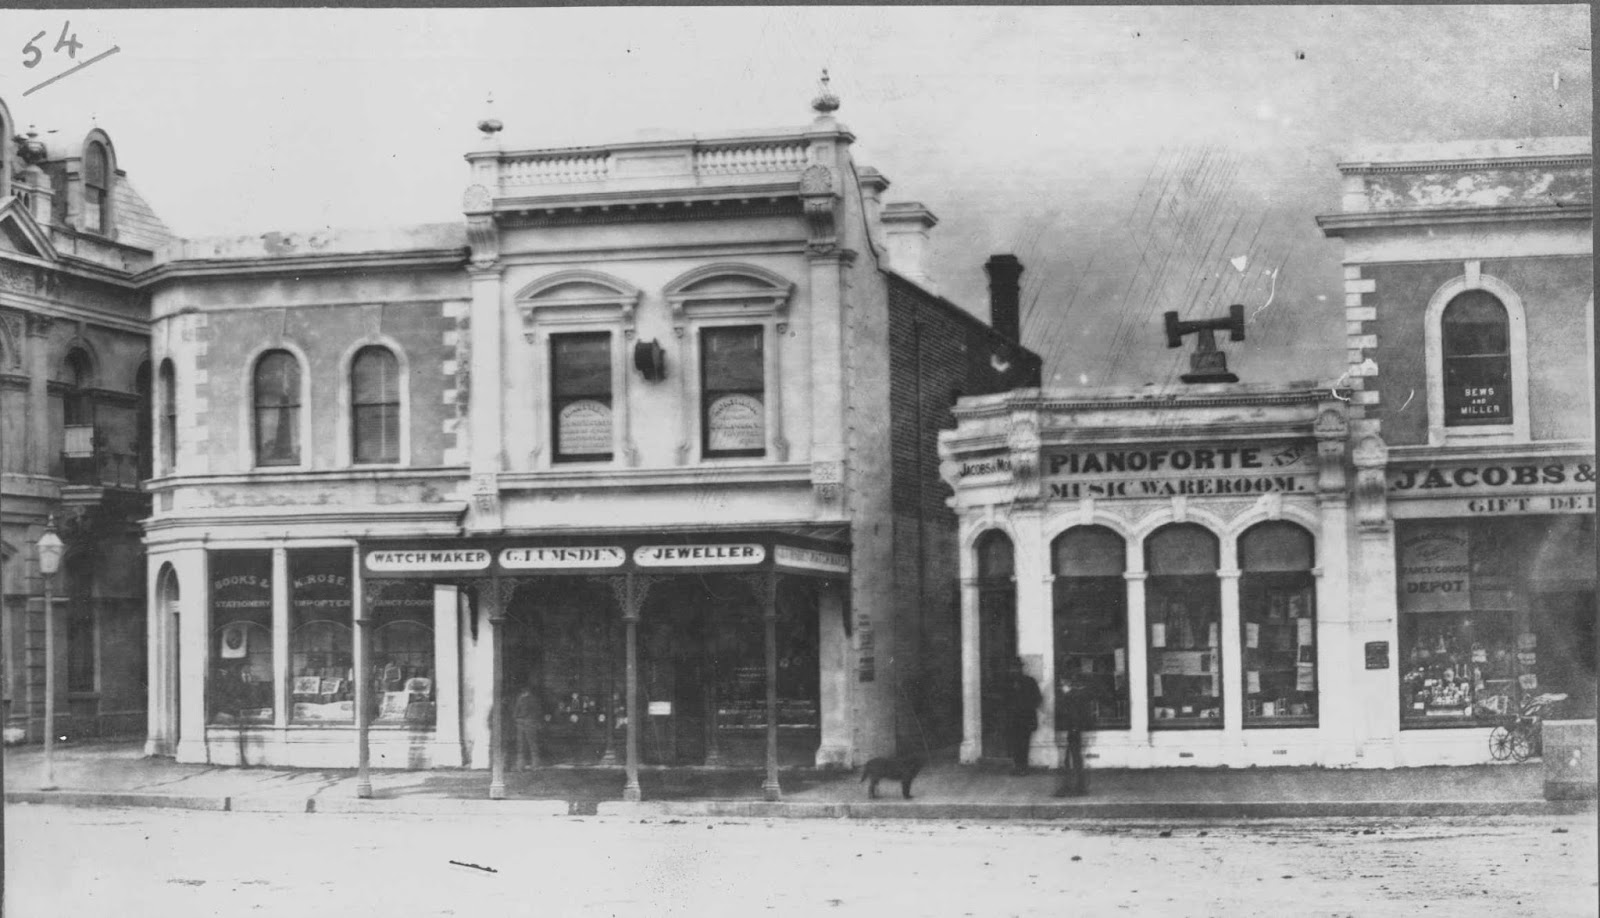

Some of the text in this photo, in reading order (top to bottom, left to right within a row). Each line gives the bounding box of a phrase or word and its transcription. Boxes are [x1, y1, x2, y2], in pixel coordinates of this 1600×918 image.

[22, 20, 84, 69] 54
[1464, 387, 1495, 397] BEWS
[1460, 404, 1500, 415] MILLER
[1049, 446, 1263, 475] PIANOFORTE
[1394, 463, 1596, 491] JACOBS &
[1050, 481, 1134, 499] MUSIC
[1467, 497, 1531, 513] GIFT
[373, 551, 487, 564] WATCHMAKER
[651, 546, 761, 561] JEWELLER.
[214, 575, 257, 590] BOOKS
[1406, 579, 1465, 594] DEPOT
